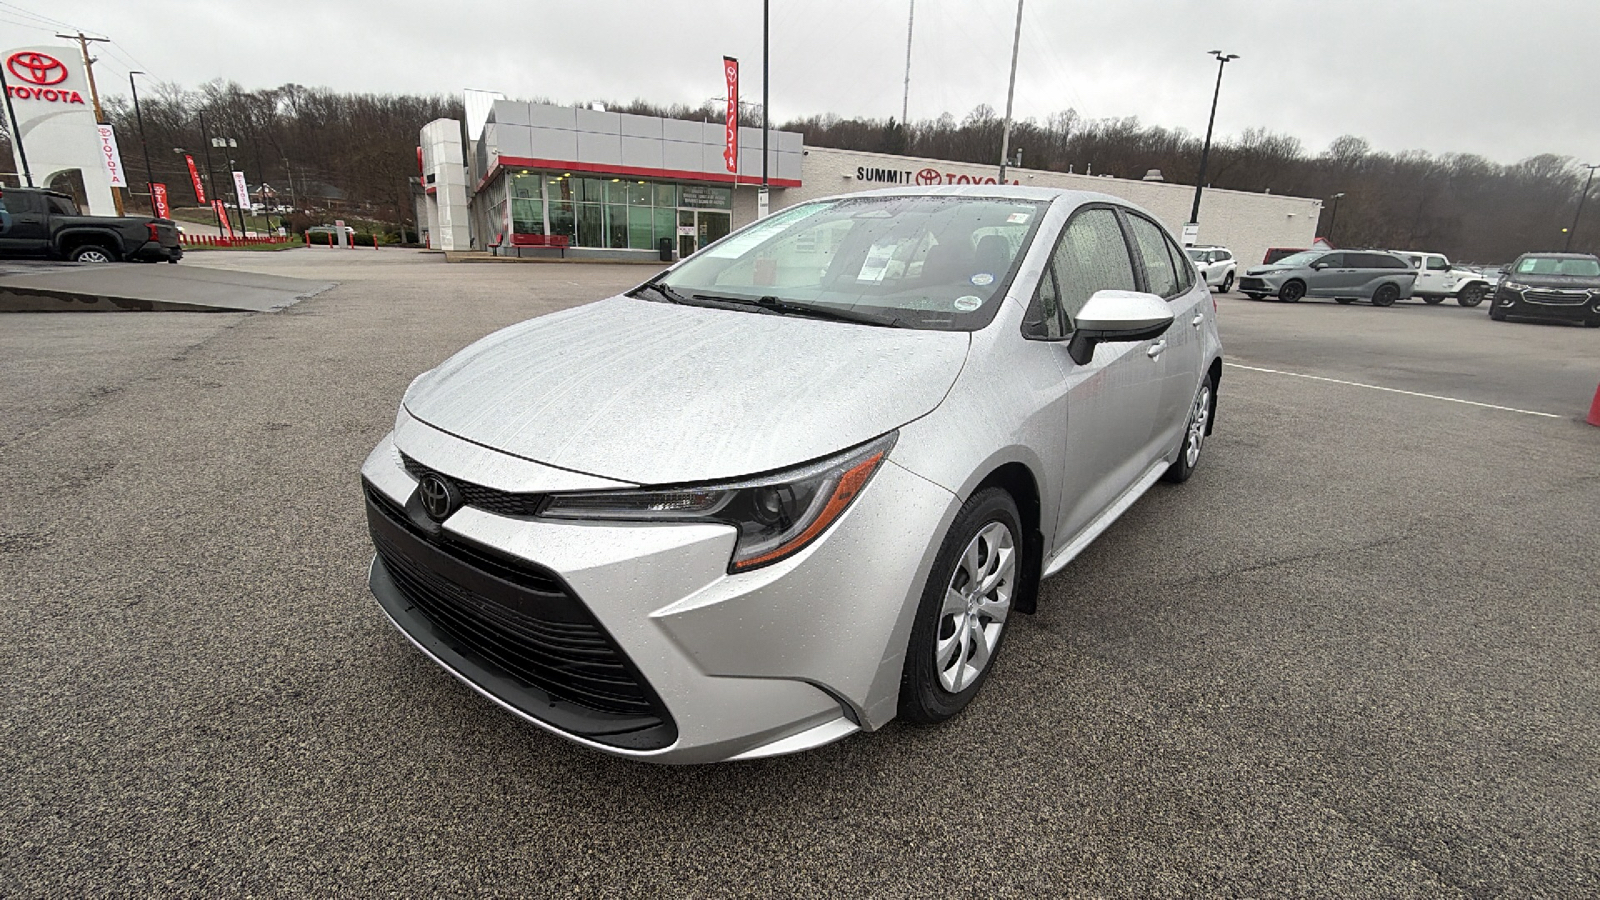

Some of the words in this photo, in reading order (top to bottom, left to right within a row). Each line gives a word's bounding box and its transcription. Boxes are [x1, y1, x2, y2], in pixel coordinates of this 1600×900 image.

[6, 84, 85, 105] TOYOTA
[102, 137, 121, 183] TOYOTA
[856, 166, 912, 184] SUMMIT
[946, 172, 1020, 185] TOYO
[155, 194, 167, 219] TOY
